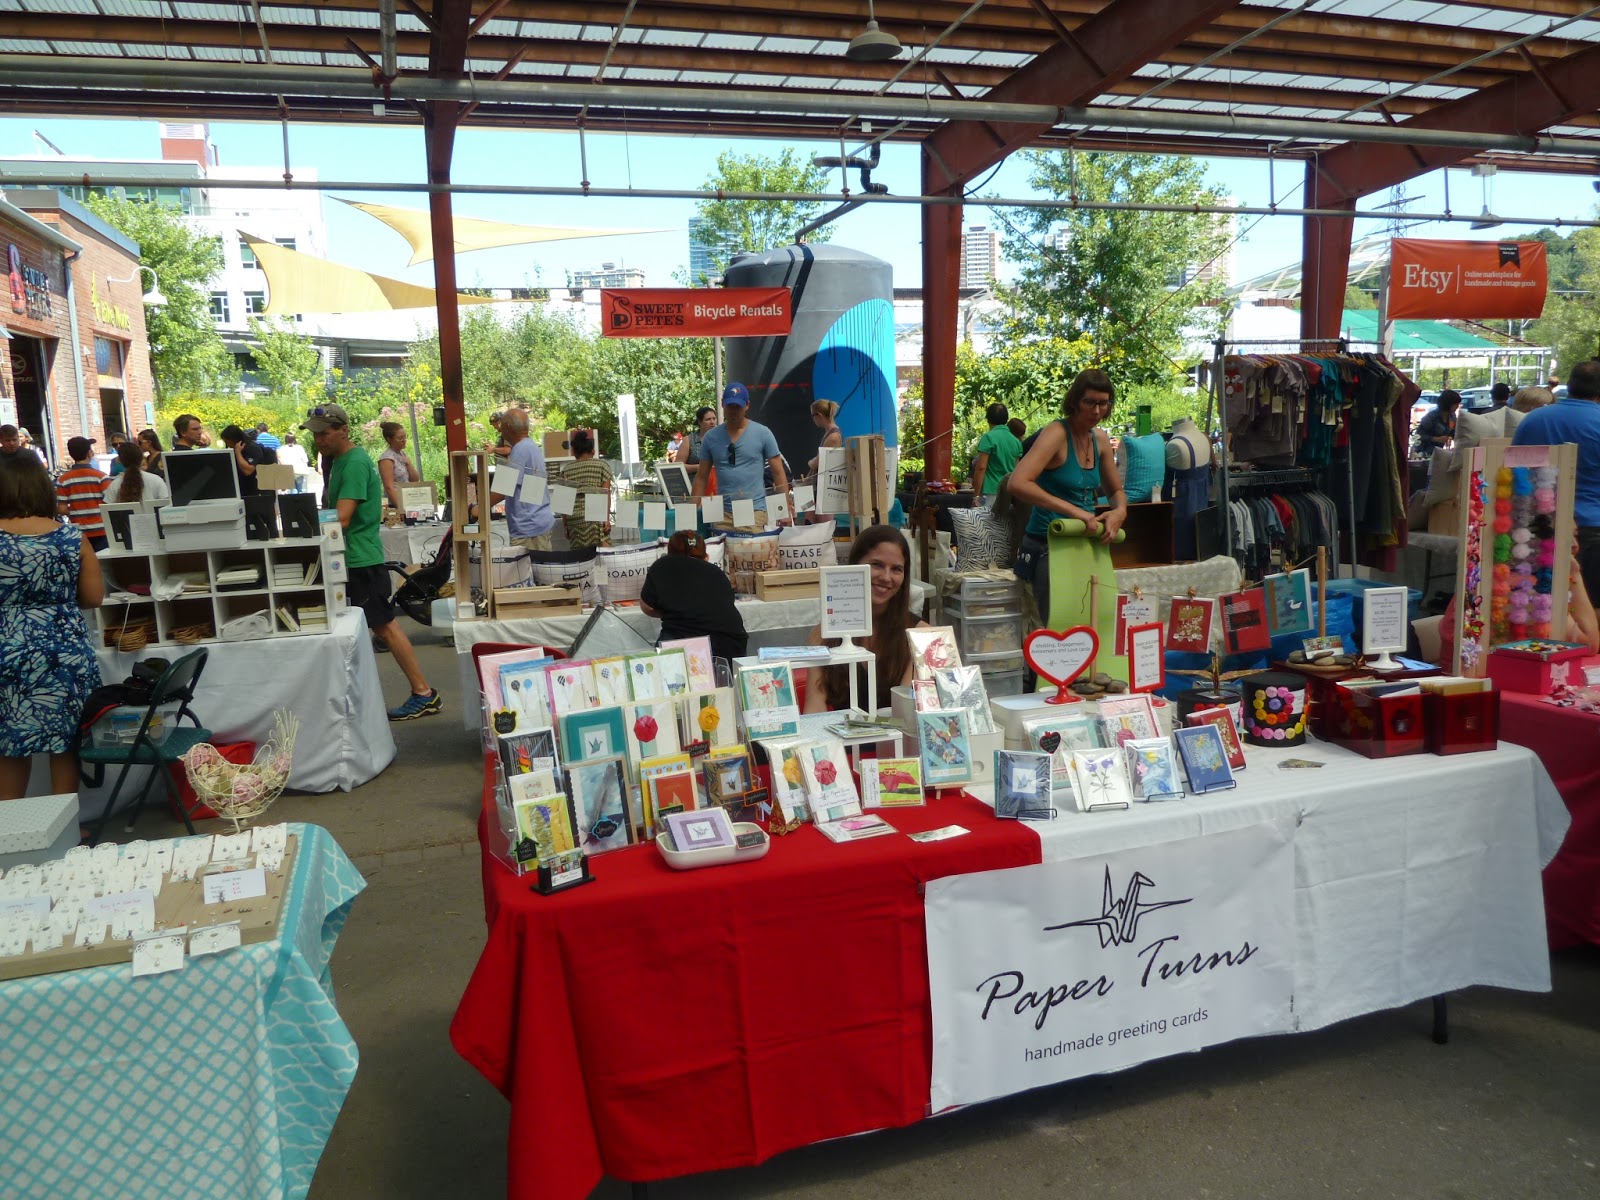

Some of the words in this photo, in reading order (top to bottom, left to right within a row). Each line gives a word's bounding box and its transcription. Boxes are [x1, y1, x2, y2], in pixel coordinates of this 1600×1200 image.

[1402, 263, 1453, 294] Etsy
[1483, 271, 1512, 279] marketplace
[1502, 280, 1521, 288] vintage
[1521, 280, 1536, 288] goods
[634, 303, 683, 314] SWEET
[694, 304, 736, 321] Bicycle
[740, 303, 783, 317] Rentals
[635, 315, 684, 326] PETE'S
[828, 474, 848, 485] TANY
[780, 547, 822, 558] PLEASE
[727, 560, 769, 570] OLLEGE
[785, 561, 818, 570] HOLD
[607, 566, 650, 578] ROADVI
[976, 970, 1115, 1031] Paper
[1137, 935, 1258, 988] Turns
[1024, 1032, 1105, 1062] handmade
[1107, 1017, 1167, 1045] greeting
[1171, 1007, 1208, 1028] cards
